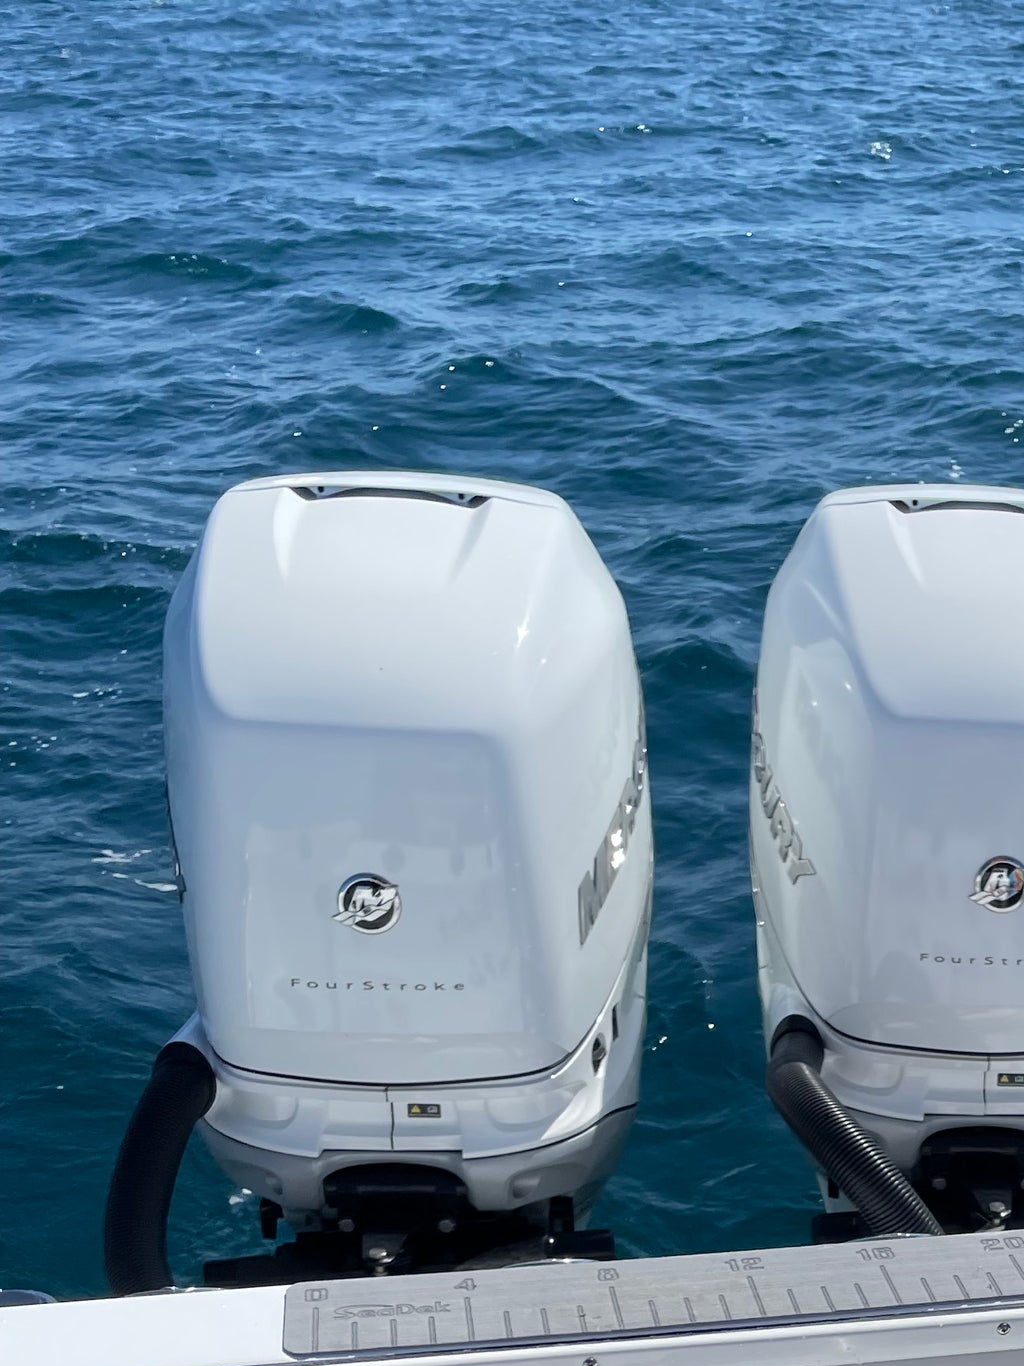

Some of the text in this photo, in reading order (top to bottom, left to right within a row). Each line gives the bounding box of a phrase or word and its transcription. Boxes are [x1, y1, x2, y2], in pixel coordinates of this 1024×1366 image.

[290, 978, 465, 992] FourStroke
[453, 1277, 477, 1292] 4
[597, 1267, 619, 1282] 8
[724, 1256, 765, 1272] 12
[333, 1301, 451, 1320] SeaDek
